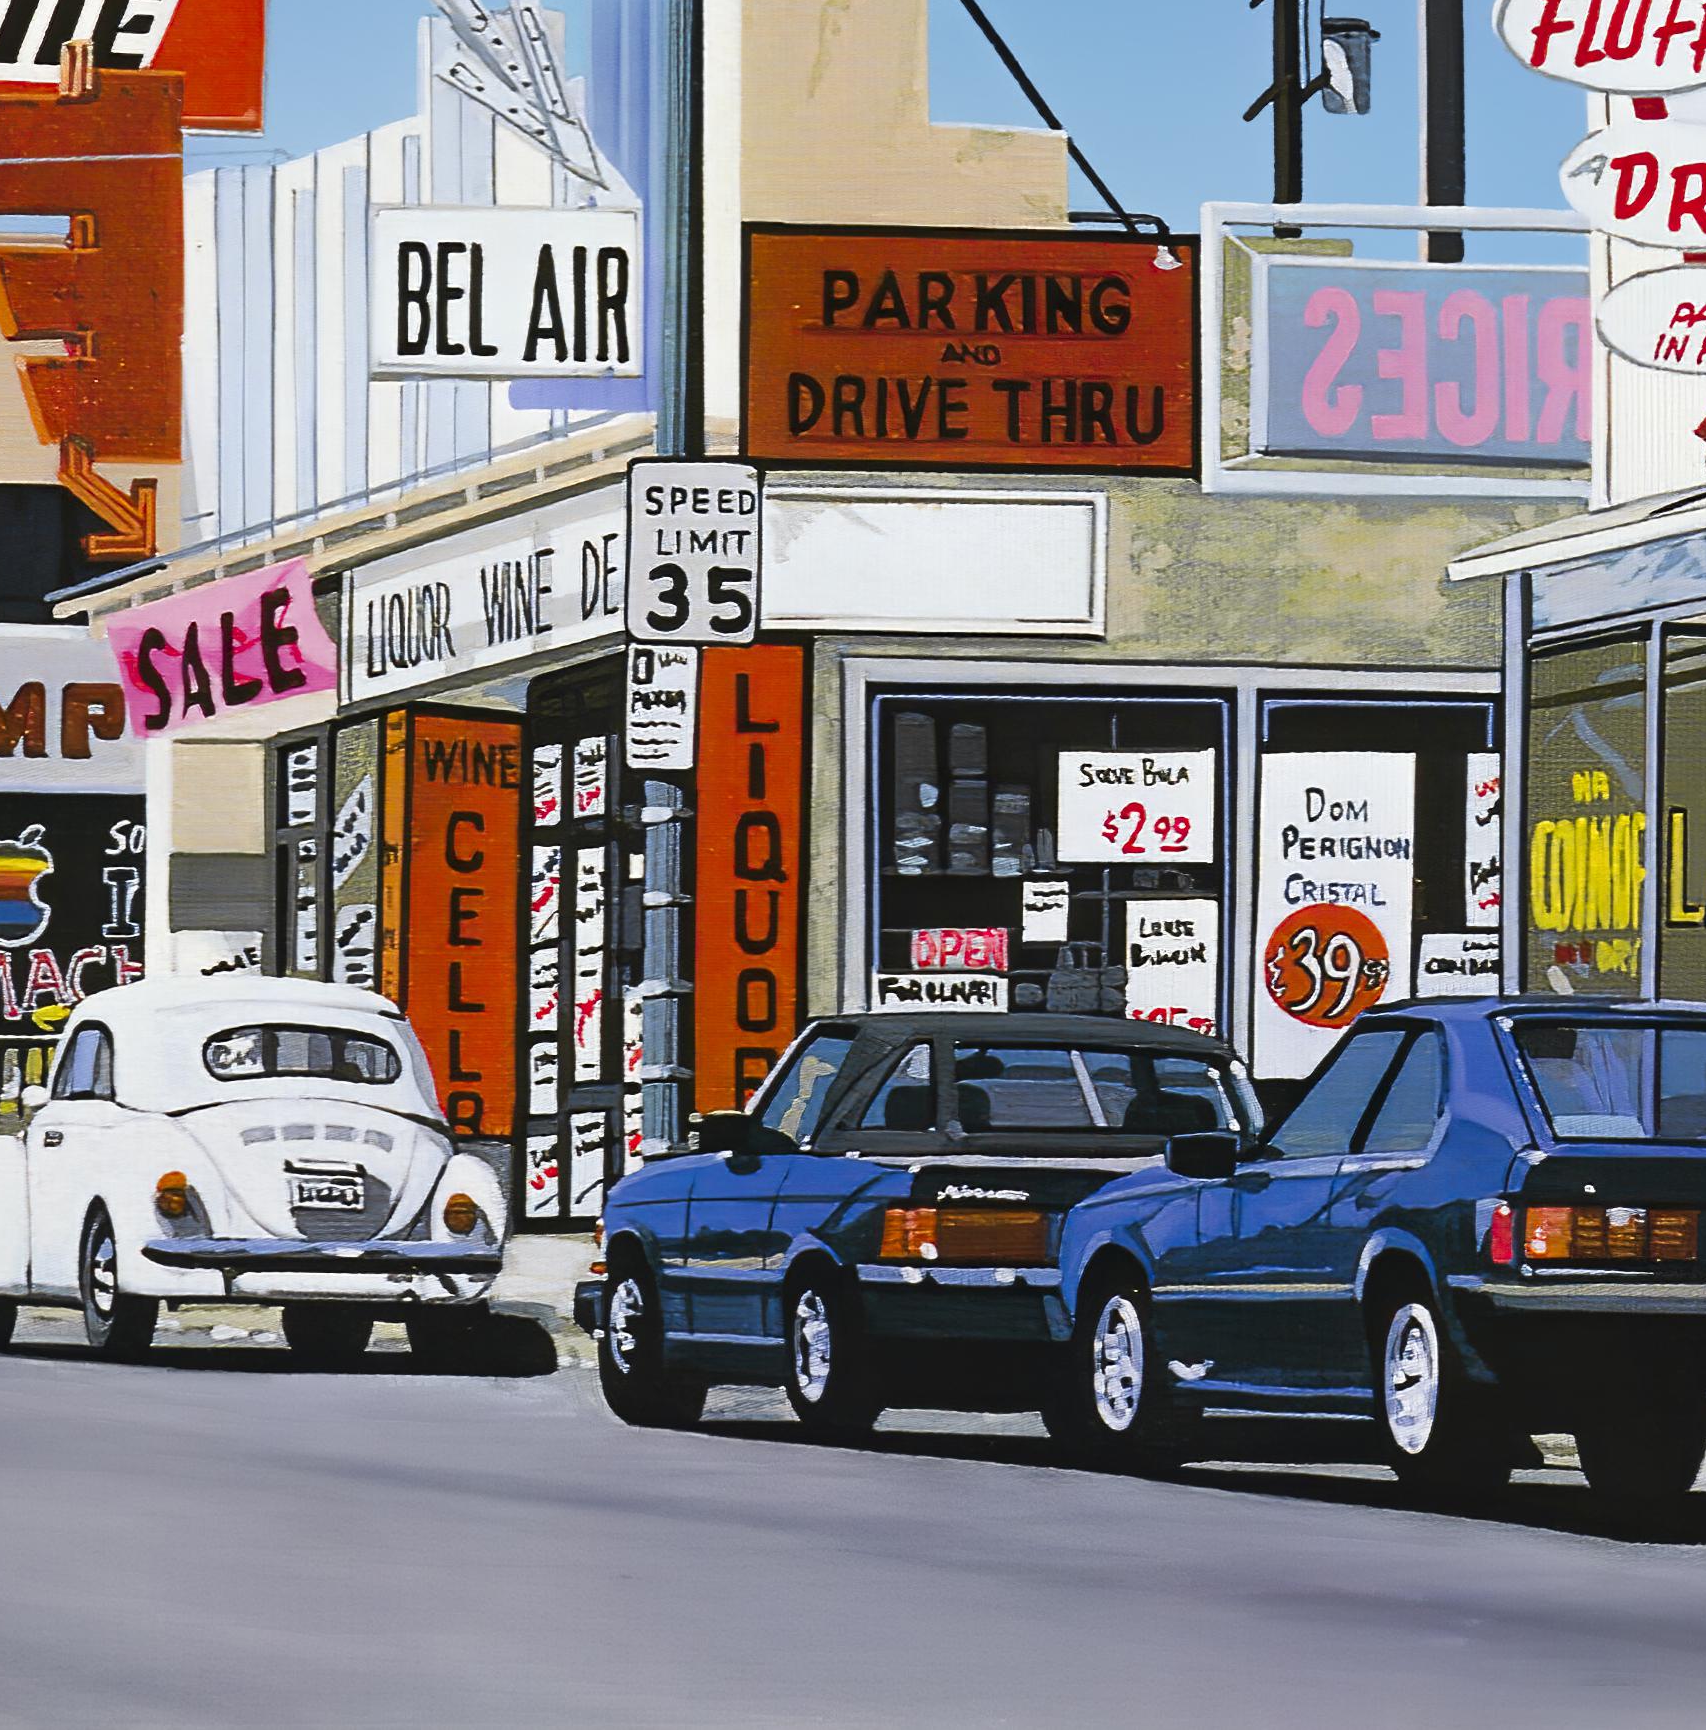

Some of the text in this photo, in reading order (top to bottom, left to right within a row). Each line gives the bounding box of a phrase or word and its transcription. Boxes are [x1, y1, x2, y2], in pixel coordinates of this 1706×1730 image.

[396, 241, 630, 364] BEL AIR
[822, 270, 1133, 336] PARKING
[940, 343, 1001, 366] AND
[1653, 332, 1690, 362] IN
[788, 372, 1166, 445] DRIVE THRU
[645, 485, 756, 516] SPEED
[656, 529, 751, 556] LIMIT
[367, 533, 619, 678] LIQUOR WINE DE
[646, 563, 753, 635] 35
[137, 586, 307, 730] SALE
[423, 738, 519, 790] WINE
[1305, 786, 1368, 823] DOM
[1282, 824, 1411, 860] PERIGNON
[734, 673, 788, 1112] LIQUOR
[1284, 873, 1387, 906] CRISTAL
[917, 927, 1009, 973] OPEN
